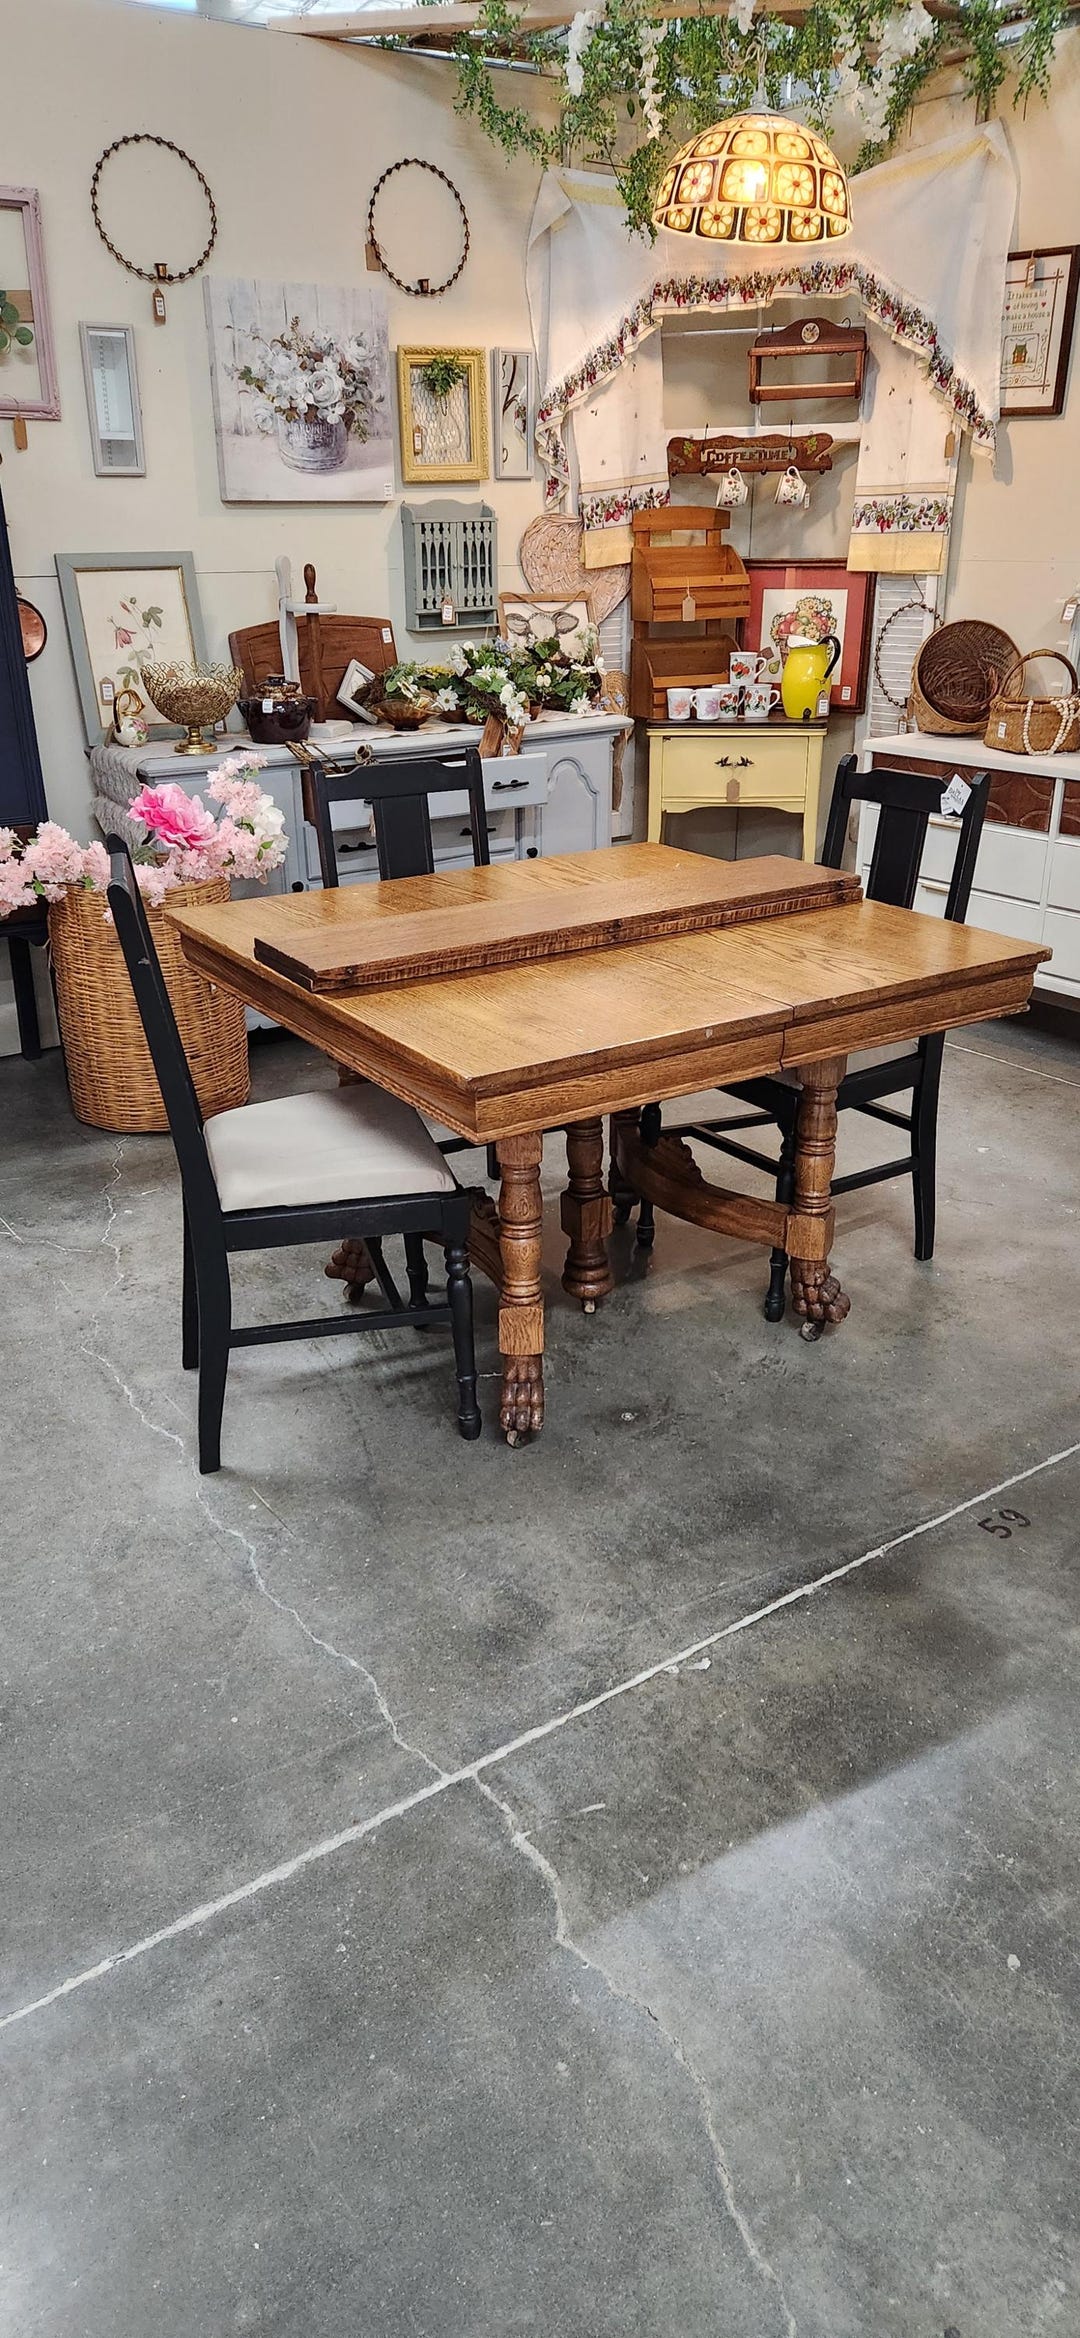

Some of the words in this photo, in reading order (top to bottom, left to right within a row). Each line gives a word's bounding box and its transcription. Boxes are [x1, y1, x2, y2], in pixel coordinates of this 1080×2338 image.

[1021, 301, 1039, 311] loving
[1028, 311, 1046, 319] house
[977, 1508, 1031, 1539] 59
